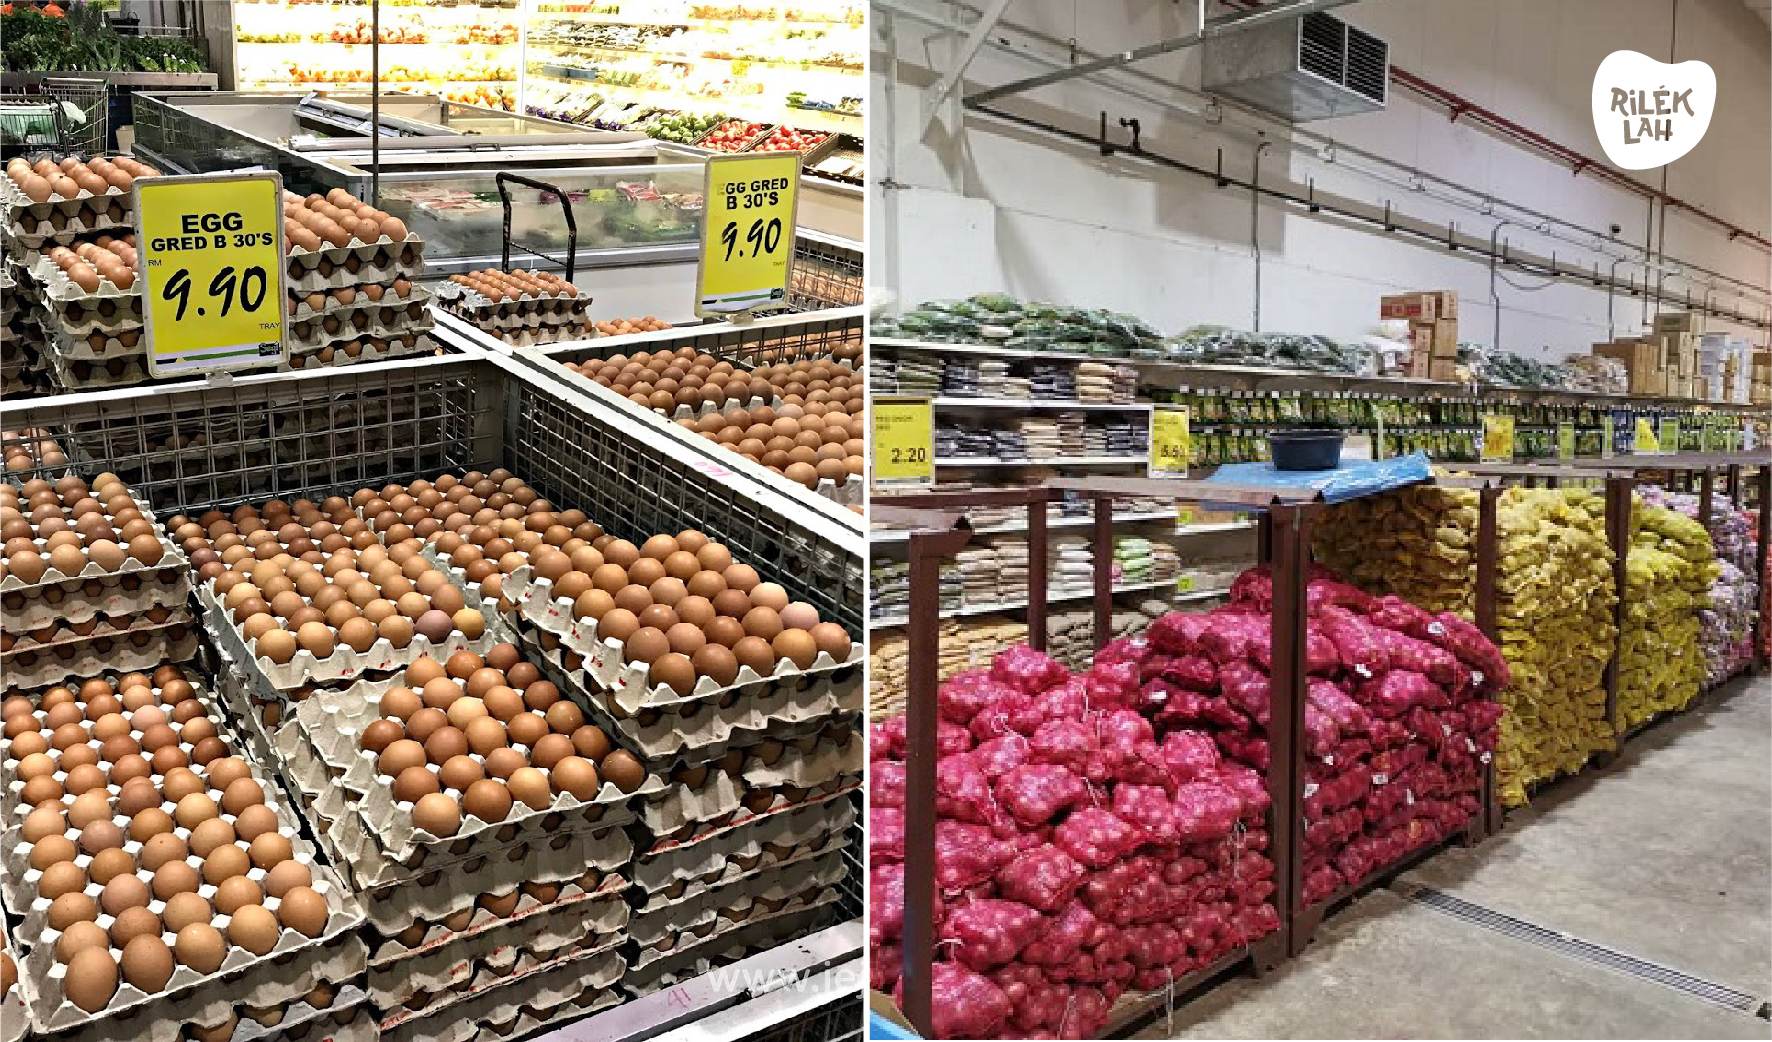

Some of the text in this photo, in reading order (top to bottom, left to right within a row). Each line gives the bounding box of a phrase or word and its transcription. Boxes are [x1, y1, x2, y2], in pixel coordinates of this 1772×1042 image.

[718, 178, 788, 195] EGG GRED
[726, 191, 779, 210] B 30'S
[181, 212, 243, 234] EGG
[151, 232, 273, 252] GRED B 30'S
[721, 217, 782, 262] 9.90
[148, 259, 162, 267] RM
[162, 265, 267, 321] 9.90
[259, 322, 280, 330] TRAY
[891, 447, 926, 464] 2.20
